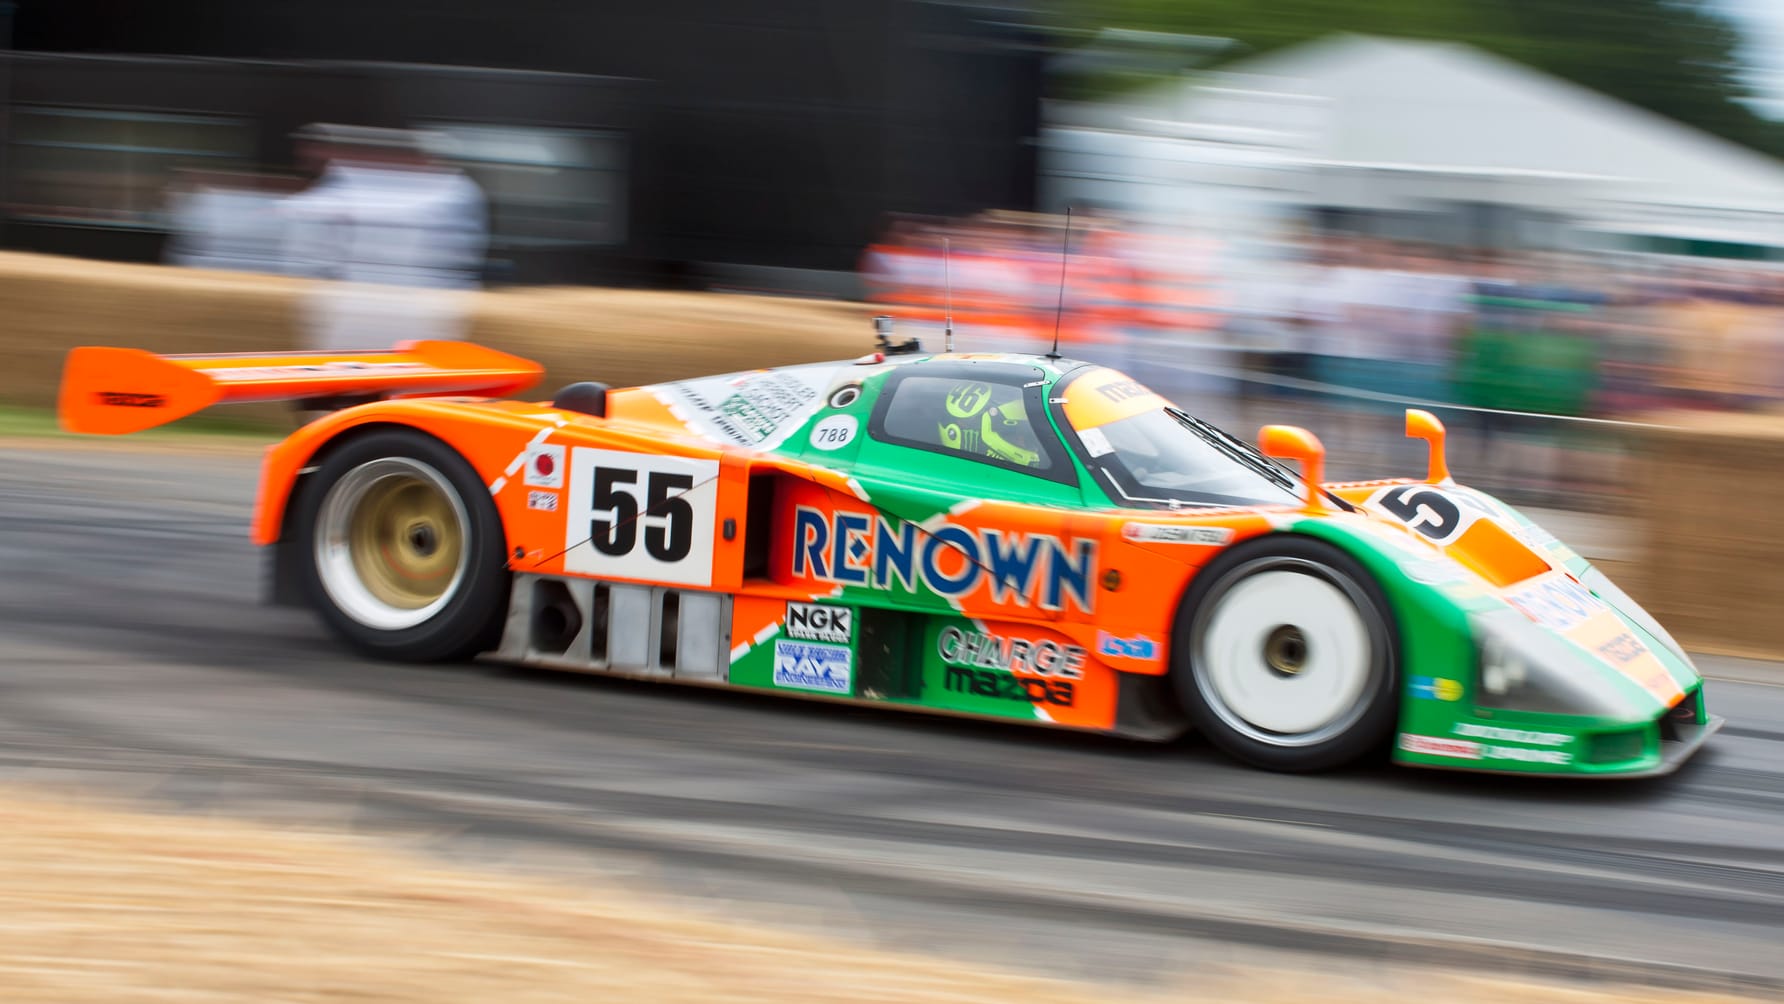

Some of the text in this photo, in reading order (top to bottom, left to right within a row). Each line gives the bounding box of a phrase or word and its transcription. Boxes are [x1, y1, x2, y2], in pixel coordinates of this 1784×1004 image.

[818, 428, 849, 442] 788
[590, 466, 694, 563] 55
[792, 504, 1098, 614] RENOWN
[790, 606, 848, 633] NGK
[779, 656, 850, 681] RAYS
[938, 625, 1088, 680] CHARGE
[945, 665, 1074, 707] mazda
